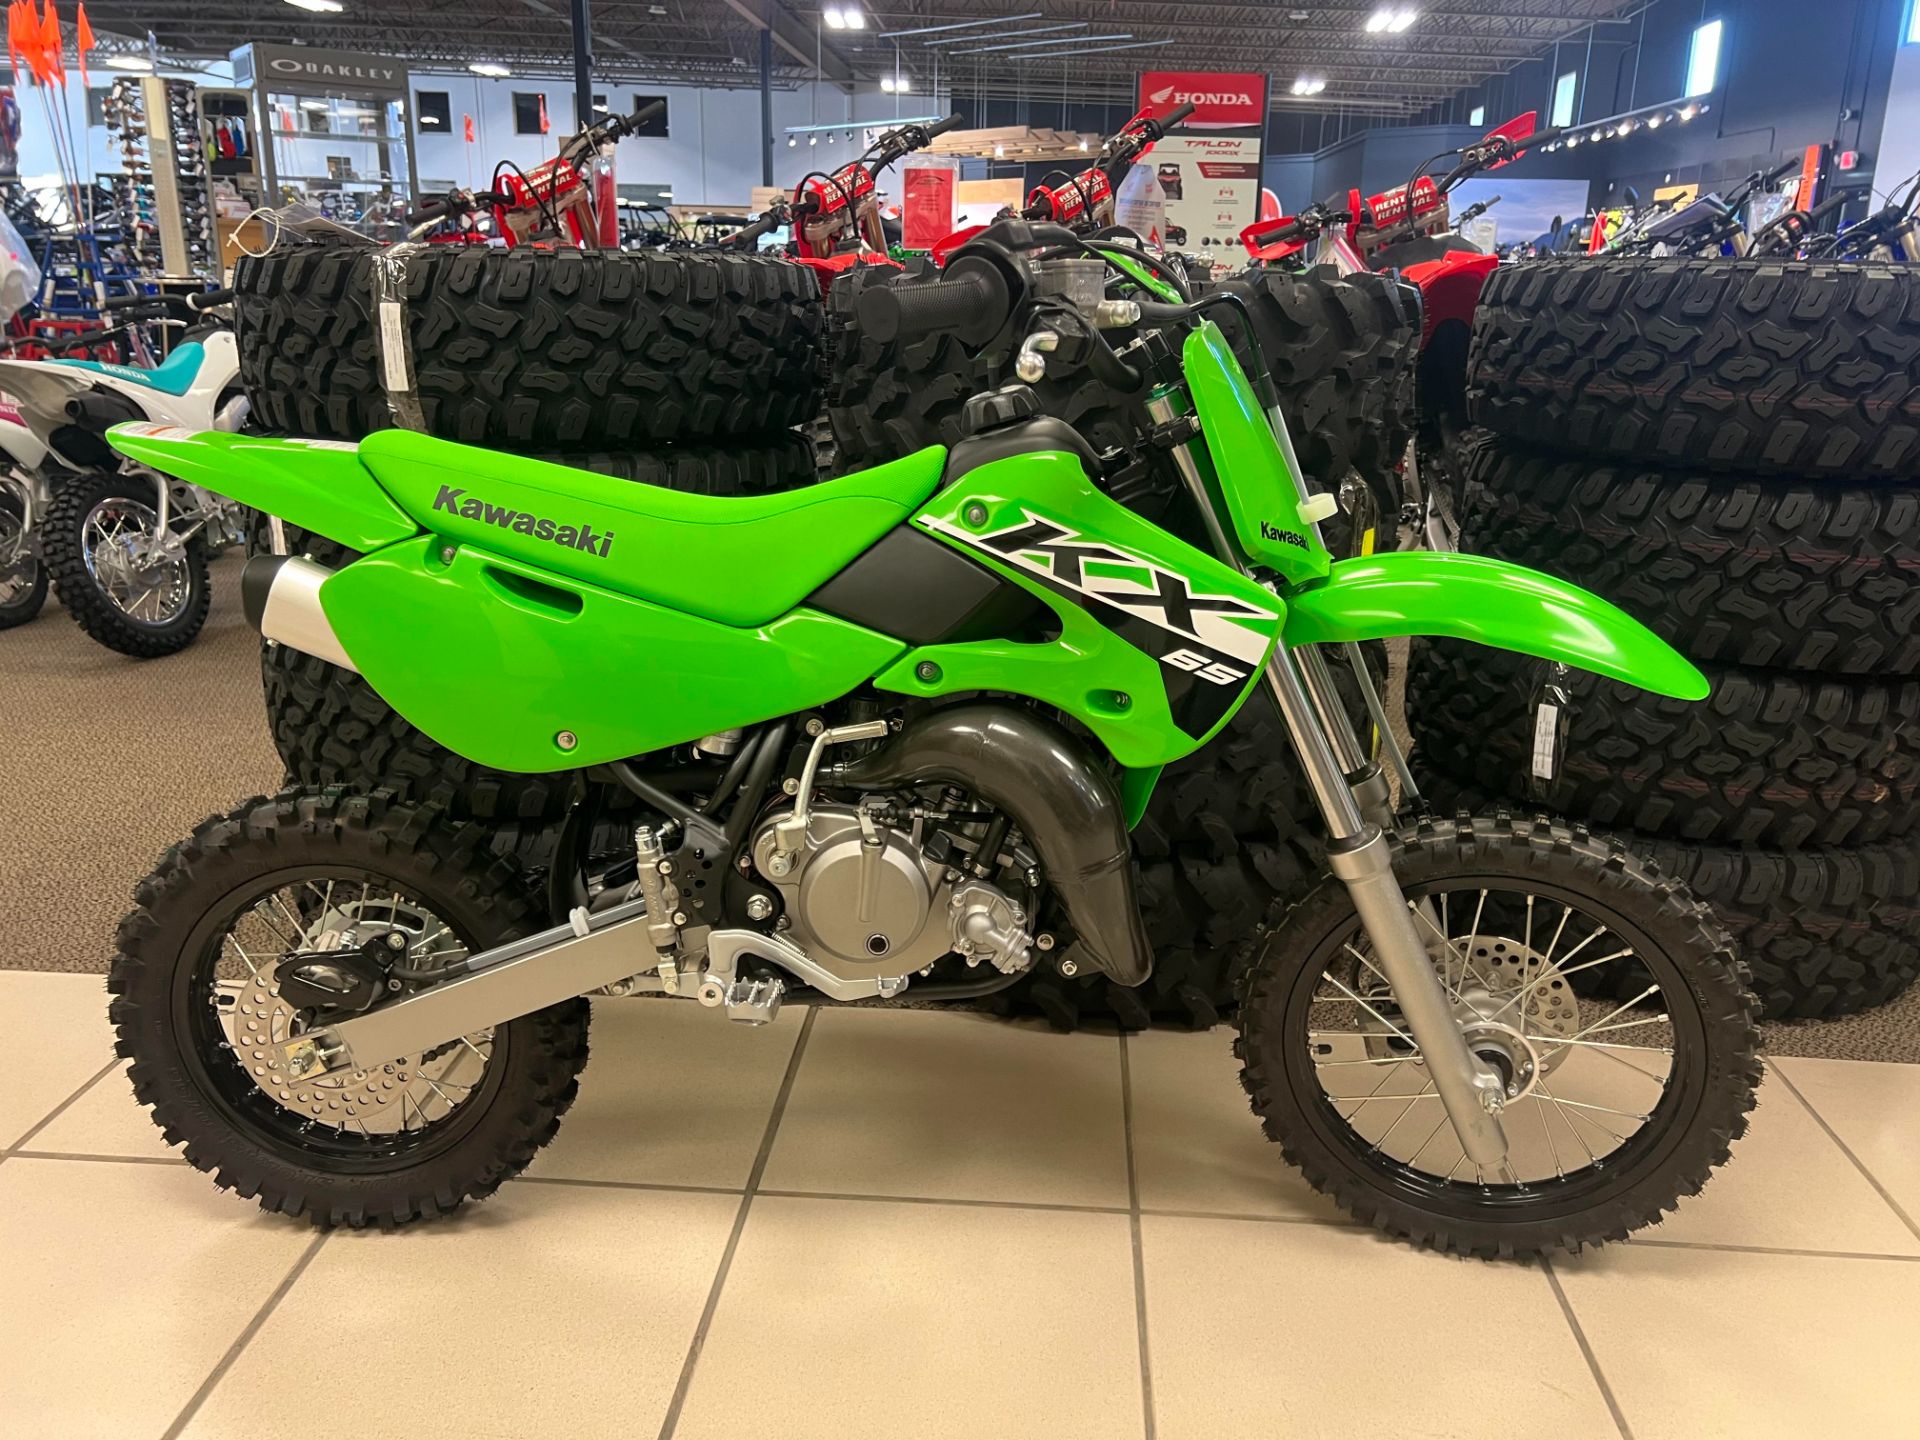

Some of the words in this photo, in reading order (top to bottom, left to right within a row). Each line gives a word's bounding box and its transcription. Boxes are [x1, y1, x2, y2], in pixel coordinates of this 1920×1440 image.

[305, 62, 393, 81] OAKLEY
[1173, 92, 1254, 106] HONDA
[1184, 140, 1242, 148] TALON
[98, 362, 151, 382] HONDA
[432, 485, 615, 558] Kawasaki
[977, 517, 1266, 639] KX
[1159, 648, 1247, 686] 65
